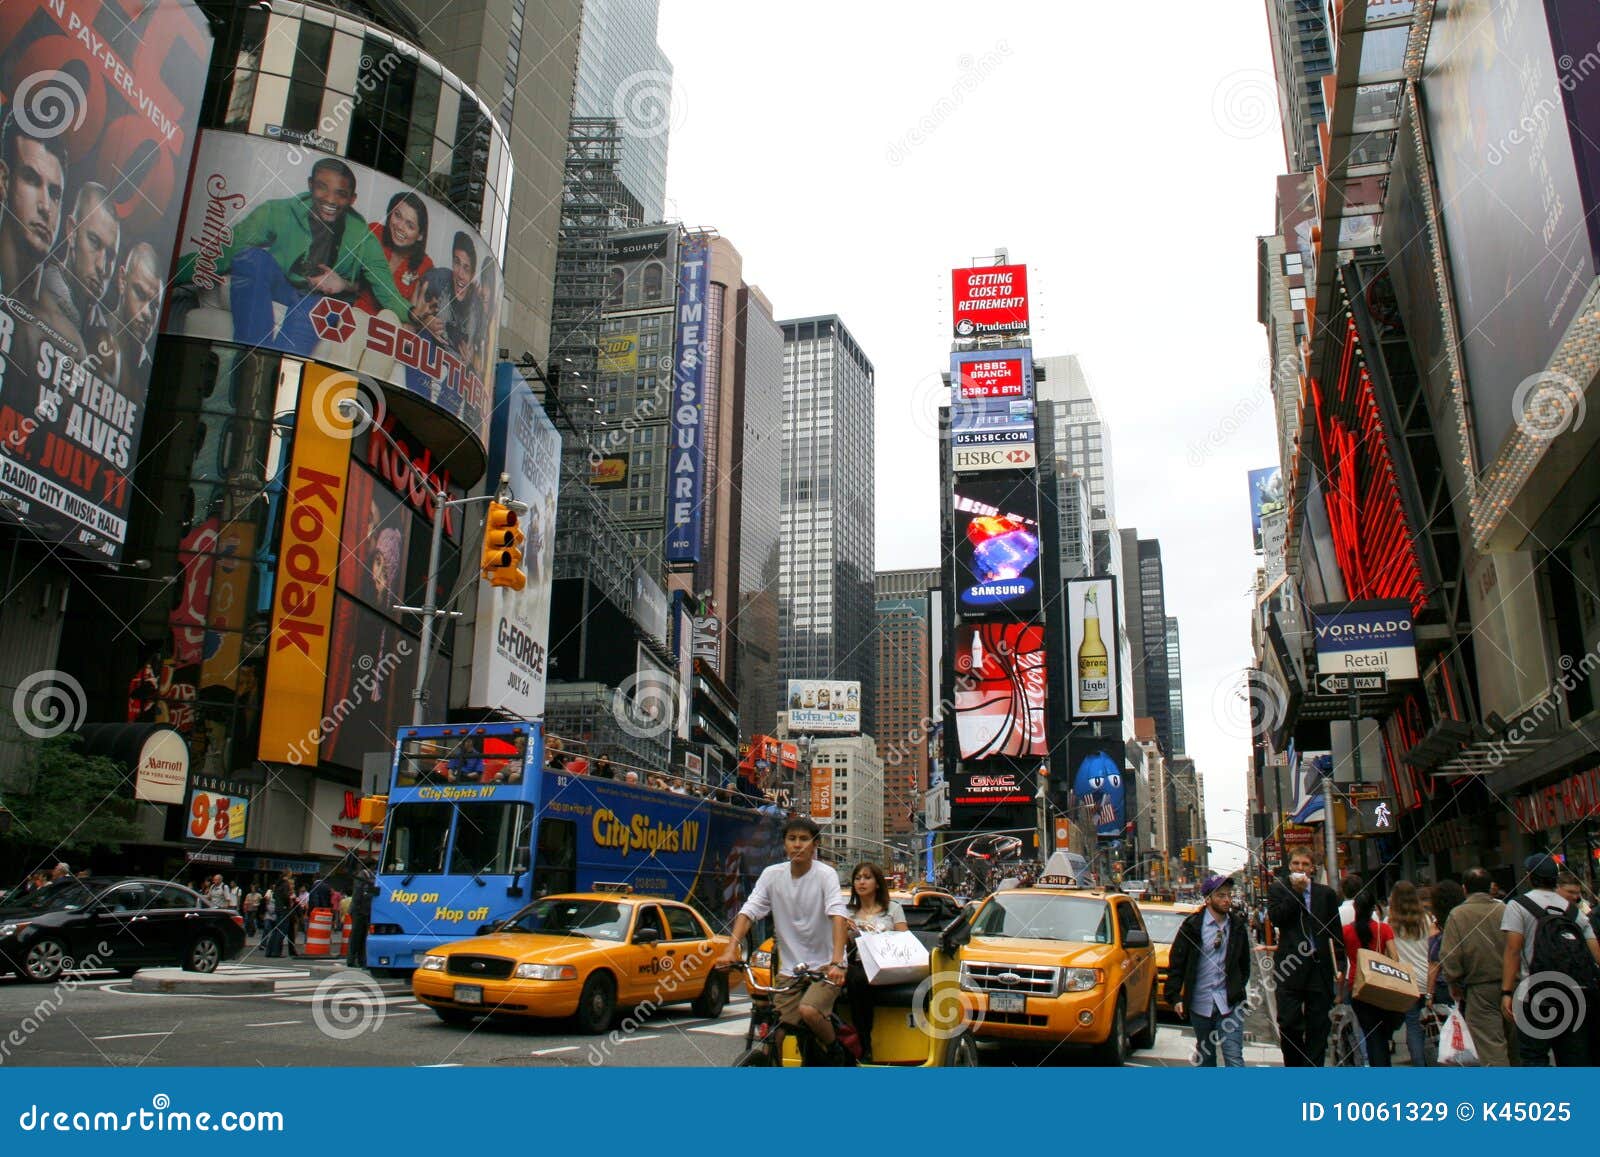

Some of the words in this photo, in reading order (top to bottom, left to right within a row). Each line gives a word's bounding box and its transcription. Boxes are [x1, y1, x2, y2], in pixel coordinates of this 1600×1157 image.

[68, 11, 178, 140] PAY-PER-VIEW
[623, 243, 660, 254] SQUARE
[967, 272, 1013, 286] GETTING
[968, 285, 998, 299] CLOSE
[999, 284, 1012, 296] TO
[958, 297, 1025, 311] RETIREMENT?
[681, 261, 704, 369] TIMES
[975, 319, 1028, 333] Prudential
[970, 369, 1012, 379] BRANCH
[974, 361, 1007, 370] HSBC
[962, 387, 989, 397] 53RD
[65, 403, 132, 470] ALVES
[956, 431, 1028, 444] US.HSBC.COM
[674, 382, 699, 524] SQUARE
[956, 450, 1004, 466] HSBC
[39, 432, 104, 492] JULY
[103, 468, 128, 510] 11
[2, 461, 38, 496] RADIO
[39, 480, 65, 508] CITY
[63, 494, 98, 524] MUSIC
[96, 515, 121, 539] HALL
[276, 465, 341, 658] Kodak
[971, 585, 1026, 597] SAMSUNG
[1315, 620, 1412, 639] VORNADO
[497, 616, 545, 675] G-FORCE
[1344, 651, 1389, 668] Retail
[507, 671, 523, 692] JULY
[521, 680, 531, 697] 24
[1326, 680, 1348, 689] ONE
[1355, 678, 1377, 688] WAY
[144, 756, 183, 772] Marriott
[193, 775, 250, 796] MARQUIS
[557, 776, 568, 787] 812
[964, 785, 1021, 793] TERRAIN
[970, 774, 1016, 787] GMC
[418, 786, 478, 802] CitySights
[478, 785, 496, 799] NY
[820, 784, 830, 811] YOGA
[591, 808, 679, 858] CitySights
[681, 820, 700, 853] NY
[390, 889, 418, 906] Hop
[421, 892, 440, 904] on
[434, 906, 464, 924] Hop
[467, 906, 490, 921] off
